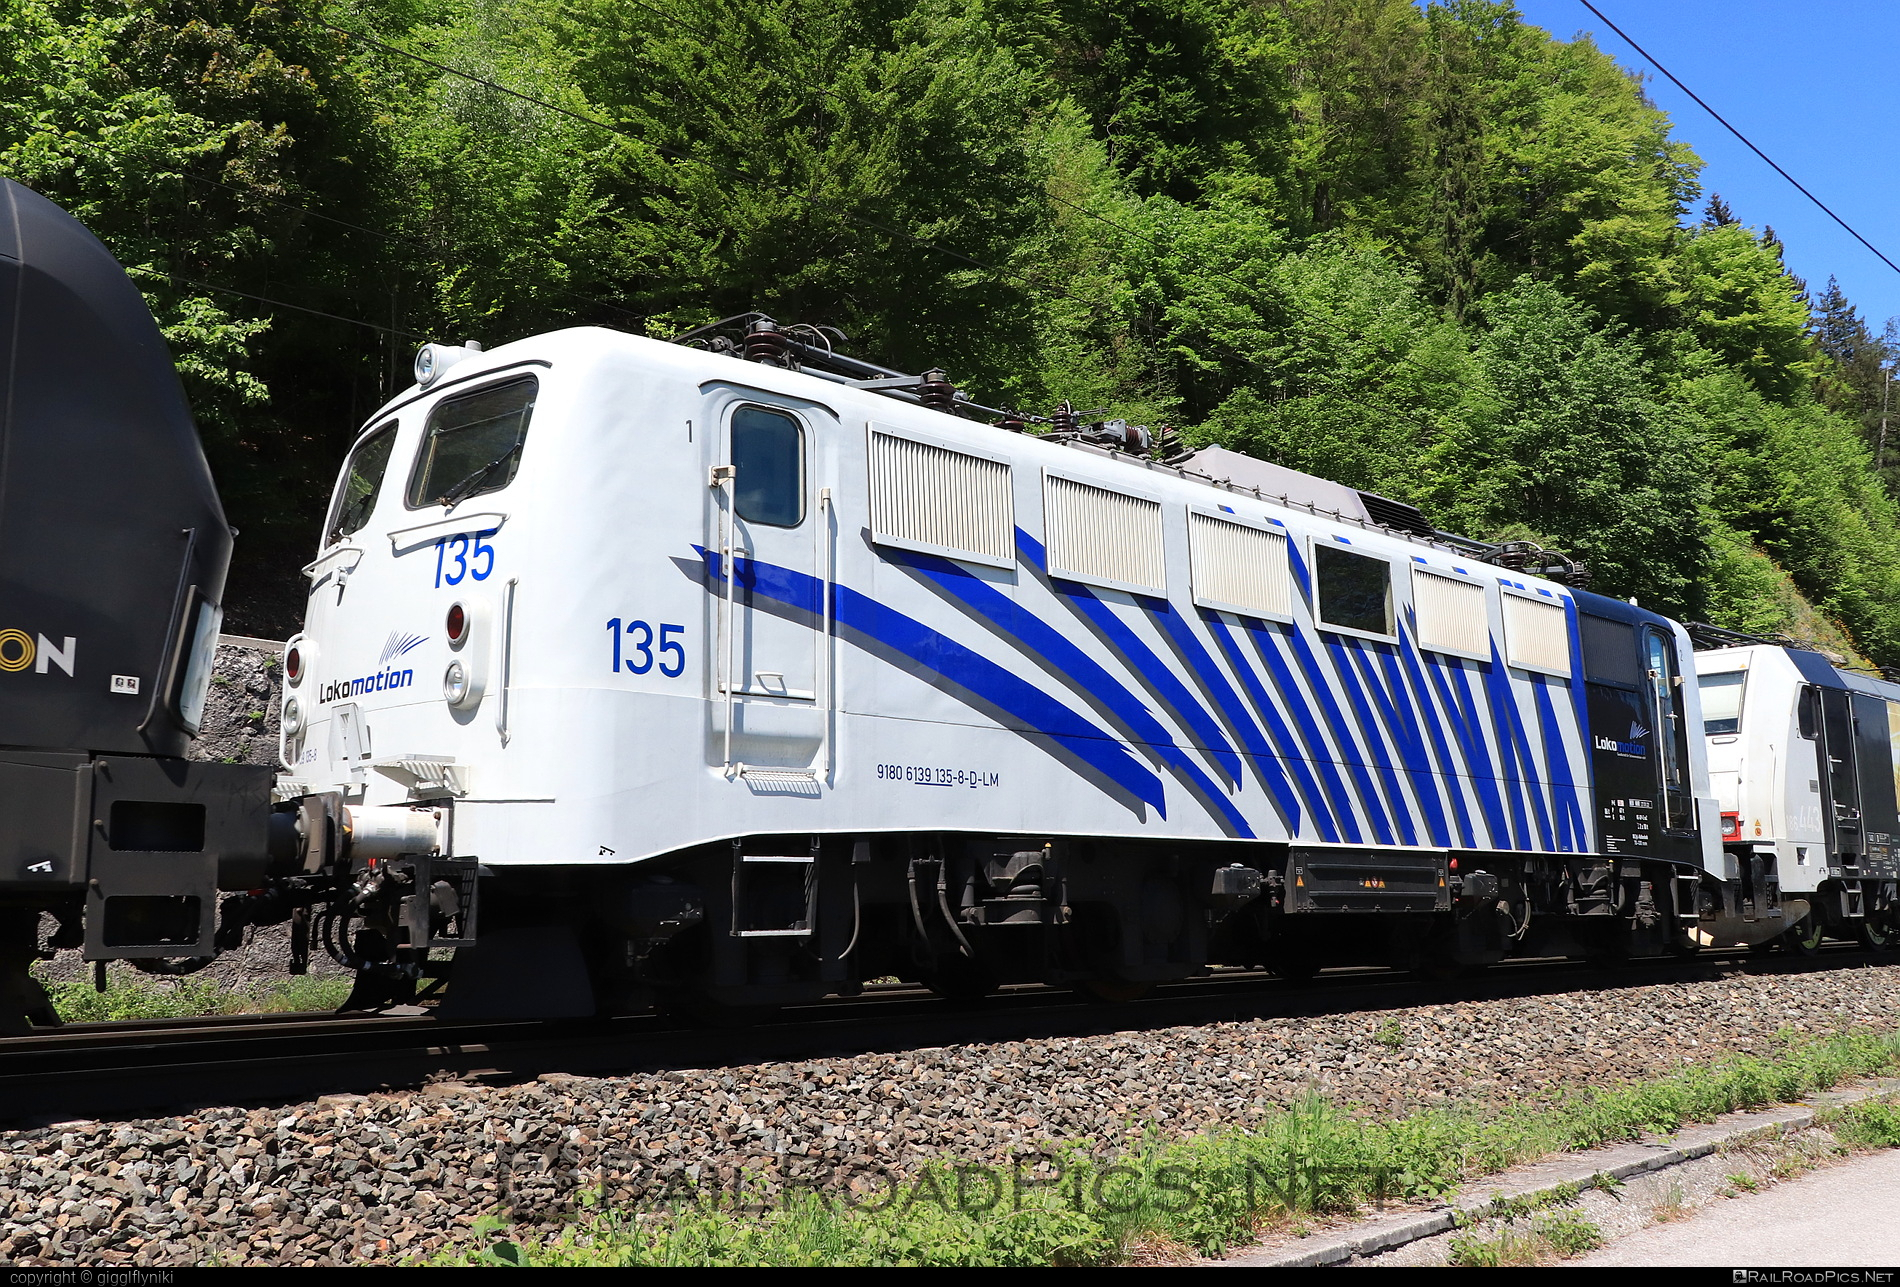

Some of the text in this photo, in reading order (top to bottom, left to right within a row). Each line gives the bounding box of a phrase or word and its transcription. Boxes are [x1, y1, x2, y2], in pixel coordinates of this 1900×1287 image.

[685, 419, 693, 443] 1
[434, 527, 498, 589] 135
[605, 617, 686, 678] 135
[319, 665, 413, 704] Lokomotion
[1594, 735, 1646, 756] Lokomotion
[877, 764, 999, 788] 9180 6139 135-8-D-LM
